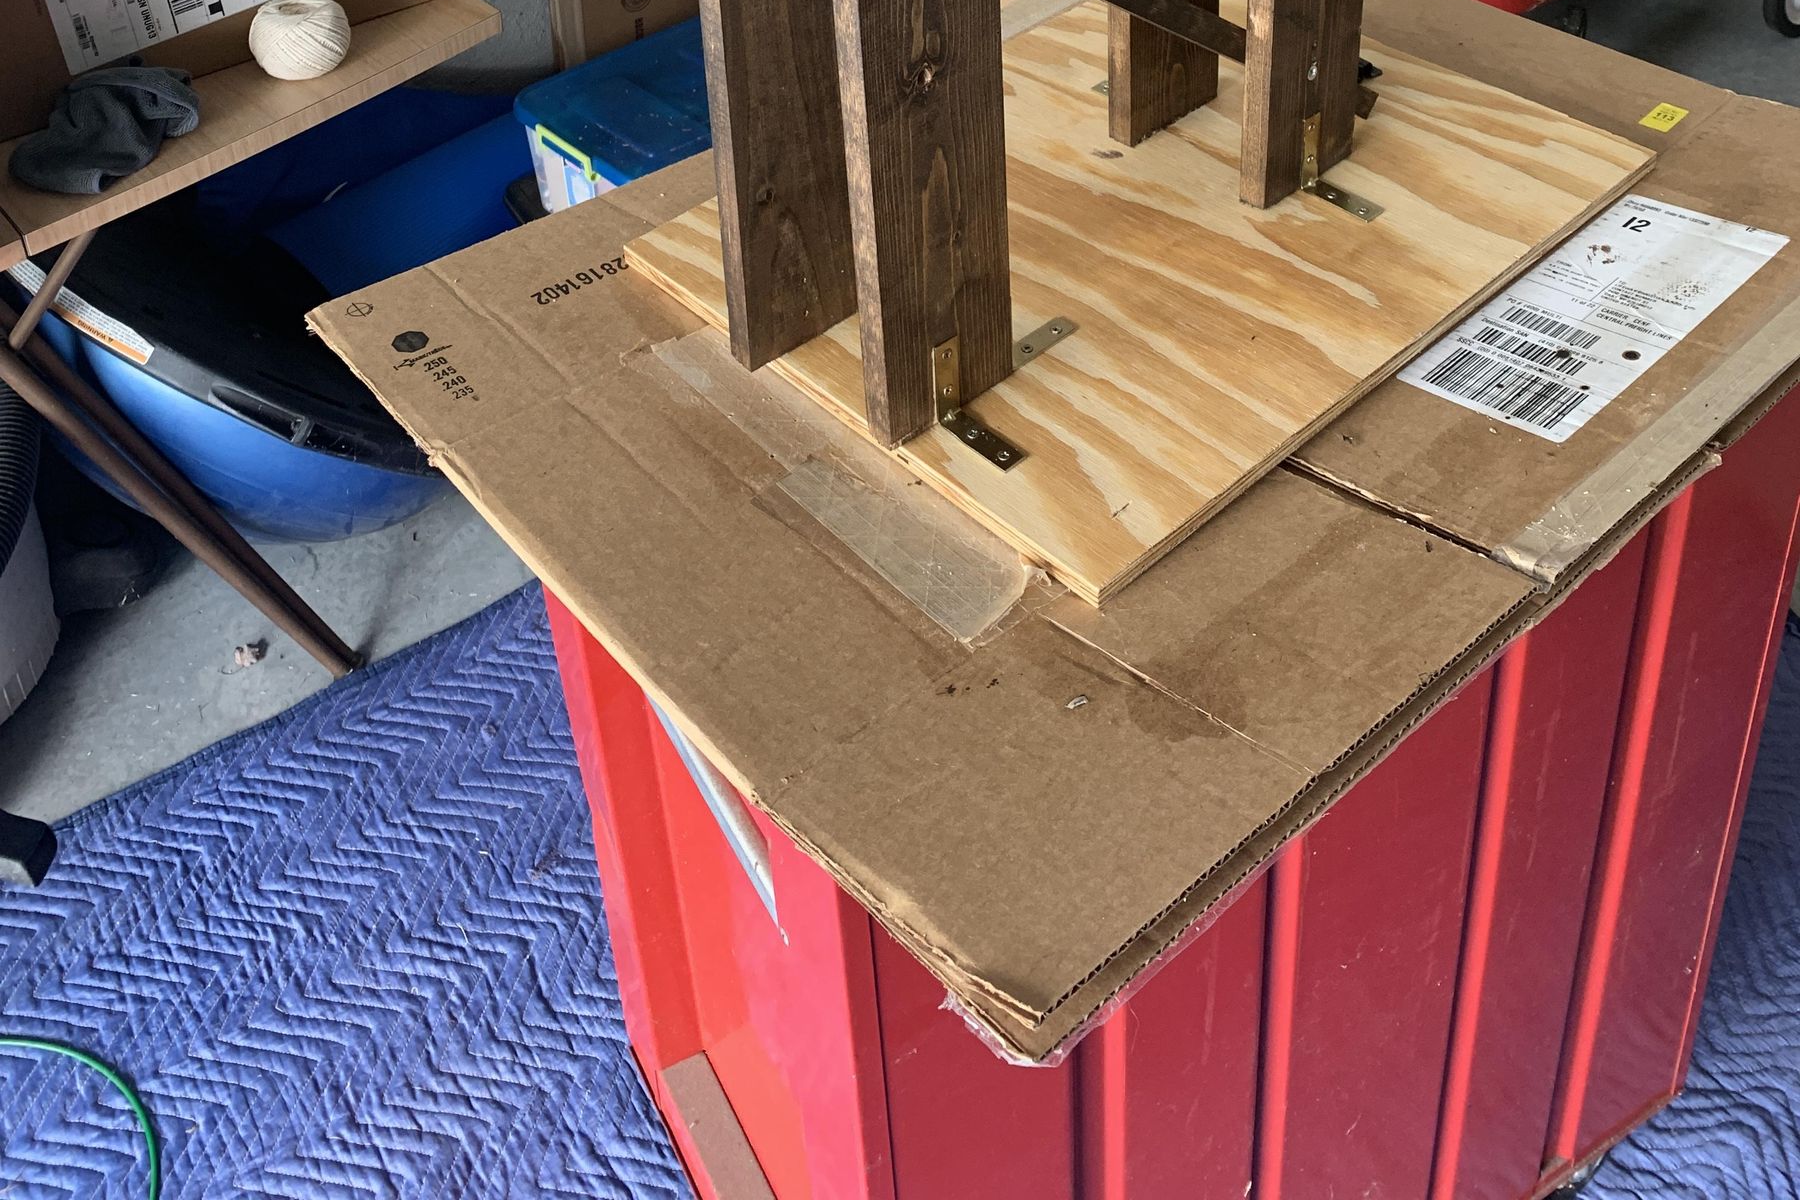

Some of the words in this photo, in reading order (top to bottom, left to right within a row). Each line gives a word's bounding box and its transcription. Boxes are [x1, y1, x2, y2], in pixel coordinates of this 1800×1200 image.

[1621, 216, 1653, 232] 12
[78, 320, 106, 340] WARNING
[1479, 317, 1516, 332] Destination
[1513, 329, 1530, 337] SAN
[1594, 312, 1625, 324] CENTRAL
[1623, 322, 1653, 334] FREIGHT
[1651, 331, 1673, 341] LINES
[424, 356, 448, 373] .250
[433, 366, 457, 382] .245
[443, 375, 467, 392] .240
[450, 385, 474, 401] .235
